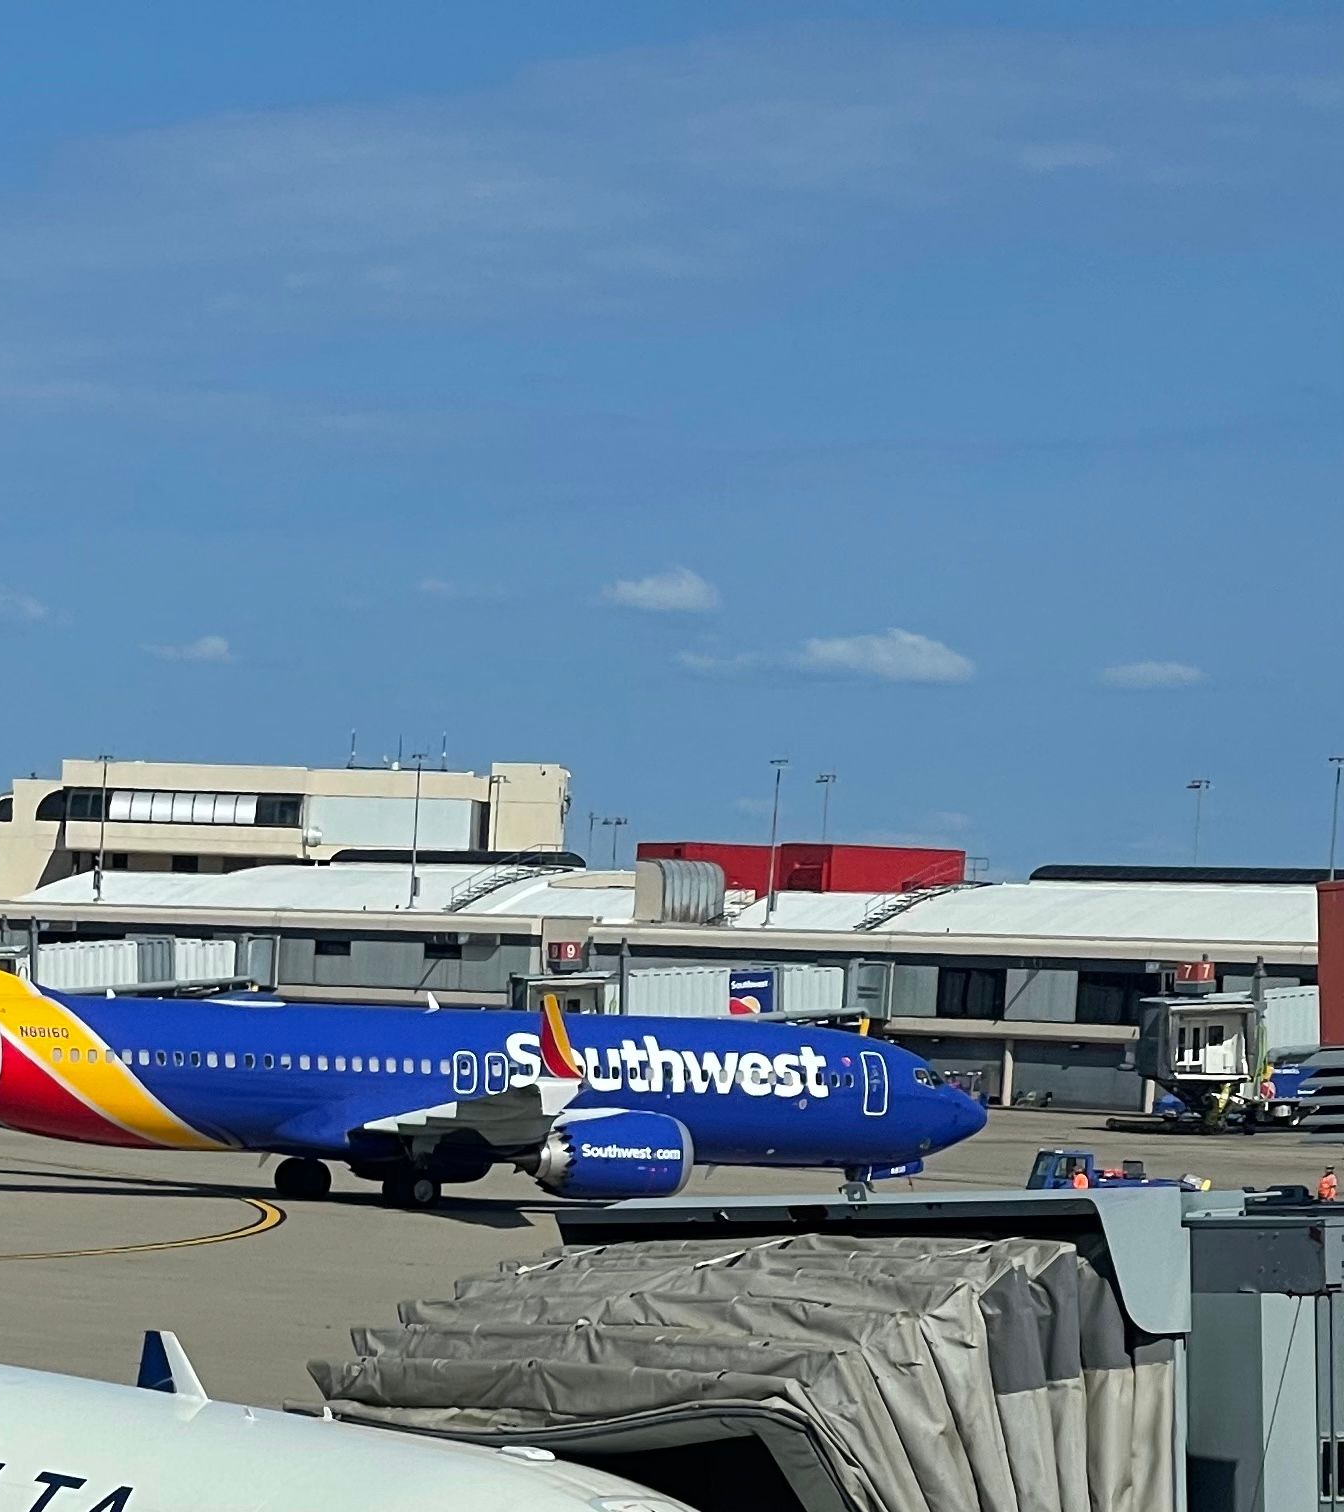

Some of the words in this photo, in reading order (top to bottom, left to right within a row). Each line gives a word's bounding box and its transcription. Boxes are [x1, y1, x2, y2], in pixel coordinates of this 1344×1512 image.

[566, 944, 576, 958] 9
[1184, 964, 1192, 979] 7
[1203, 963, 1211, 979] 7
[505, 1032, 829, 1098] Suthwest
